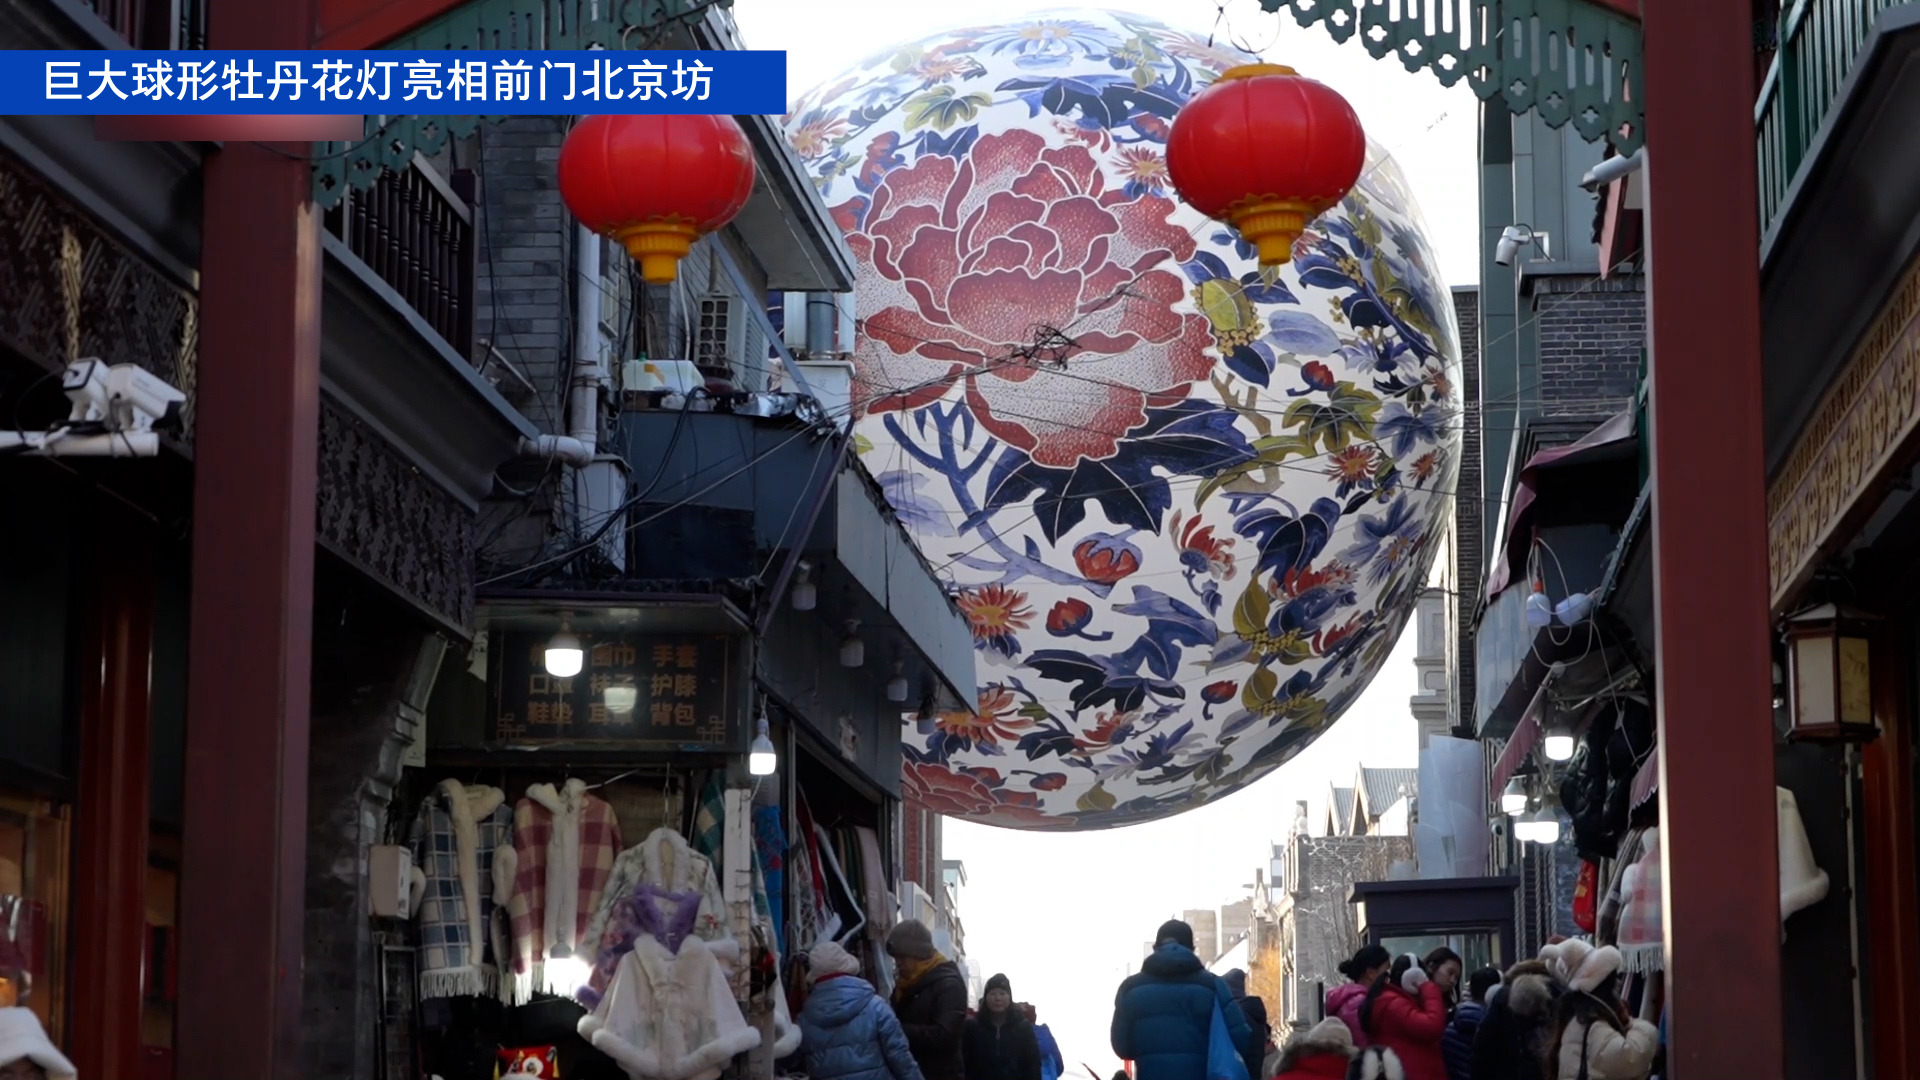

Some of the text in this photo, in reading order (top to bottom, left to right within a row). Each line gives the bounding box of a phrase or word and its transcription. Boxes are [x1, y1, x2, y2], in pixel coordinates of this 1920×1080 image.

[652, 644, 697, 667] 手套
[651, 673, 697, 696] 护膝
[527, 701, 573, 725] 鞋垫
[650, 702, 696, 726] 背包
